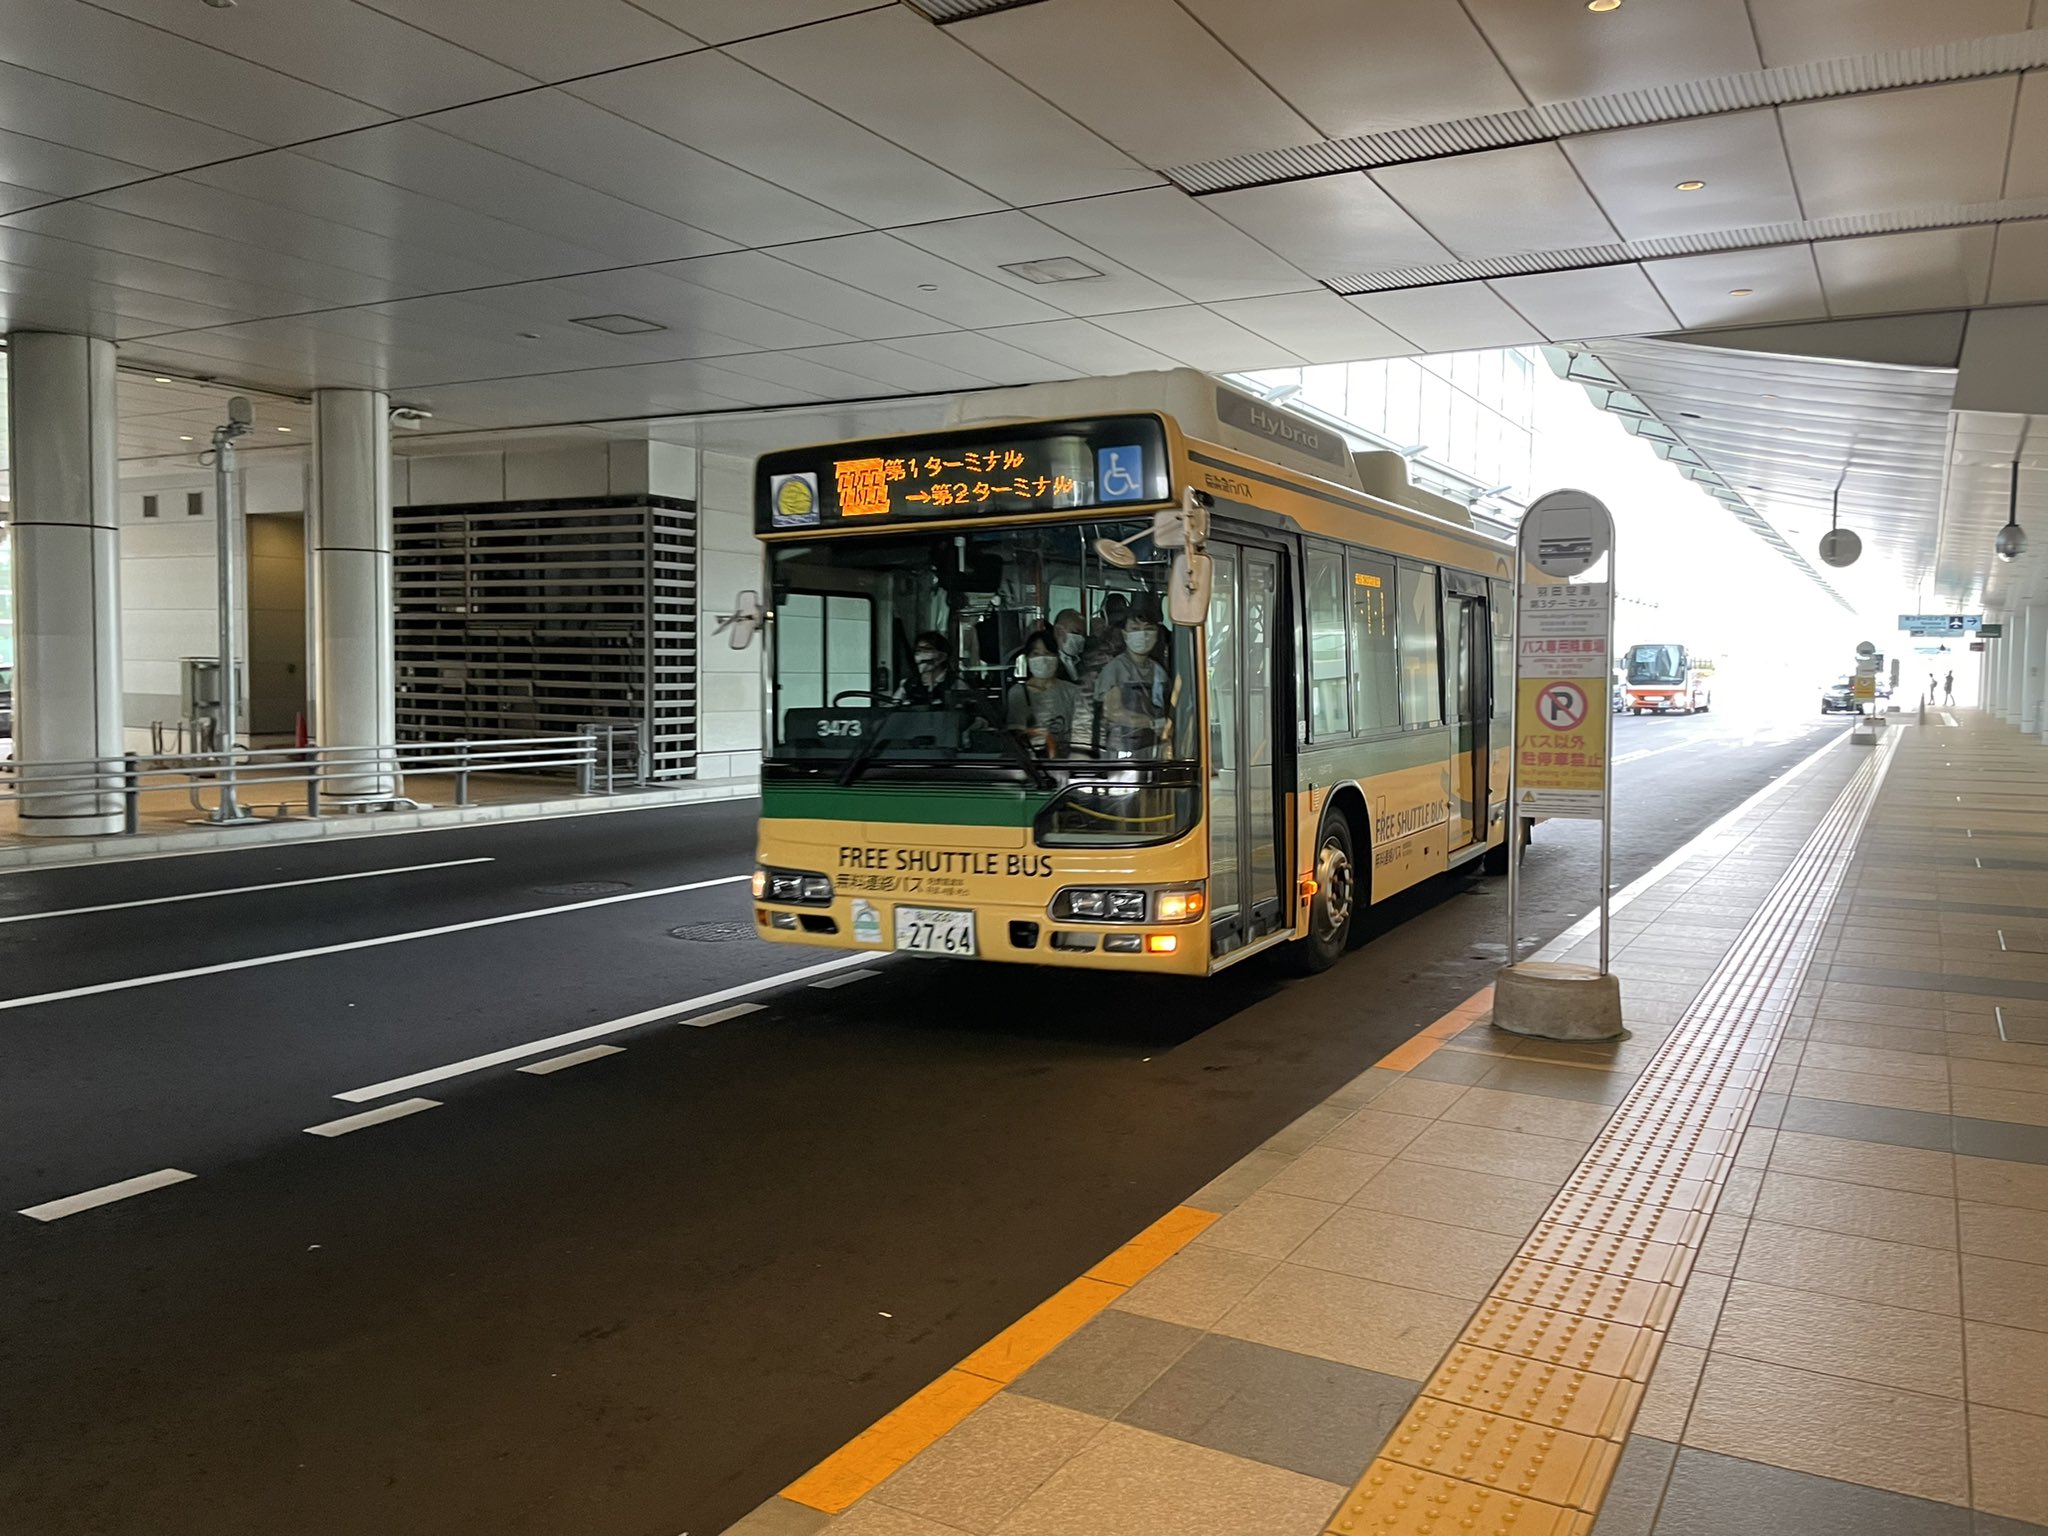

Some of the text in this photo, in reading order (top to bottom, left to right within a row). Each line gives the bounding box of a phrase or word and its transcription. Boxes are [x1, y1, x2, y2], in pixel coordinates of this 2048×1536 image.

[1250, 407, 1319, 449] Hybrid
[884, 450, 1025, 481] 第1ターミナル
[930, 474, 1073, 506] 第2ターミナル
[817, 719, 862, 737] 3473
[1520, 734, 1585, 750] バス以外
[1376, 801, 1444, 843] FREE SHUTTLE BUS
[839, 846, 1053, 878] FREE SHUTTLE BUS
[908, 922, 971, 953] 27-64
